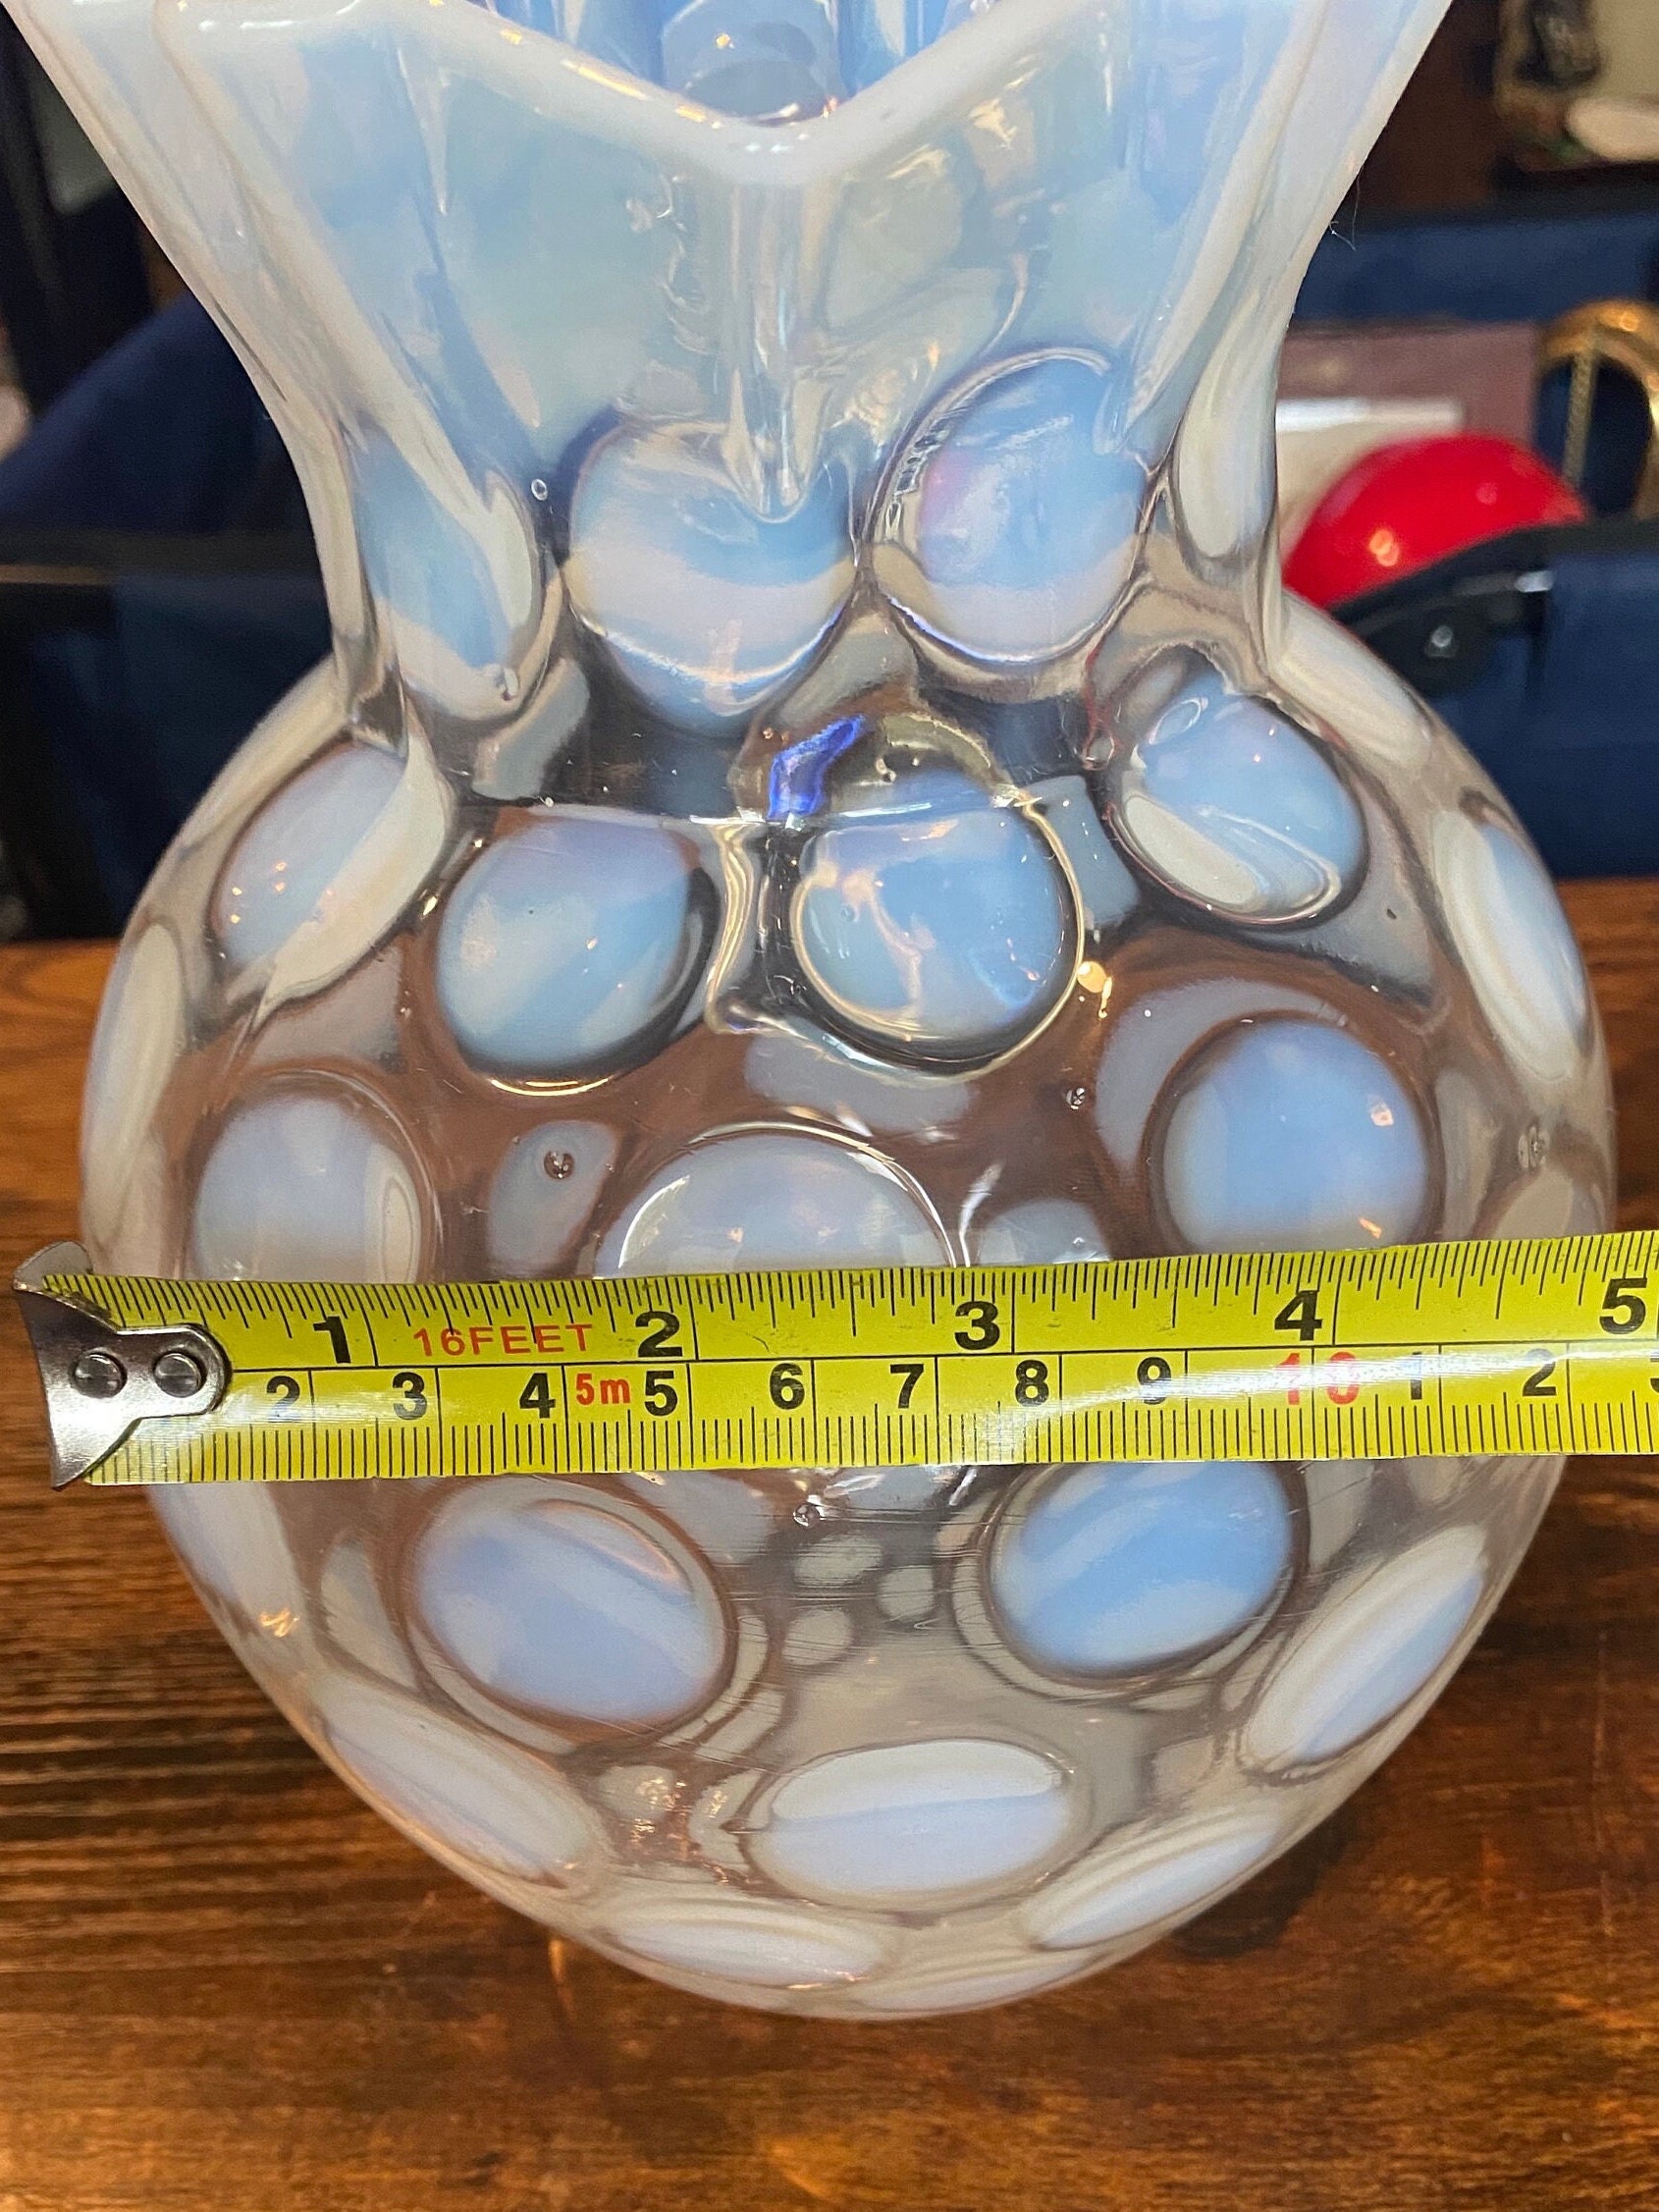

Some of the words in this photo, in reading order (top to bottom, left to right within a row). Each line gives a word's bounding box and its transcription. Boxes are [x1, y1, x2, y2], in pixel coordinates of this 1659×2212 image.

[314, 1316, 352, 1364] 1
[413, 1323, 592, 1357] 16FEET
[635, 1311, 682, 1359] 2
[954, 1301, 1000, 1351] 3
[1274, 1290, 1322, 1341] 4
[1599, 1278, 1647, 1335] 5
[266, 1376, 302, 1424] 2
[392, 1372, 427, 1420] 3
[518, 1373, 556, 1419] 4
[575, 1373, 631, 1406] 5m
[644, 1370, 678, 1417] 5
[769, 1363, 805, 1410] 6
[889, 1363, 925, 1409] 7
[1014, 1359, 1049, 1407] 8
[1137, 1357, 1172, 1405] 9
[1276, 1352, 1361, 1405] 10
[1523, 1348, 1557, 1397] 2
